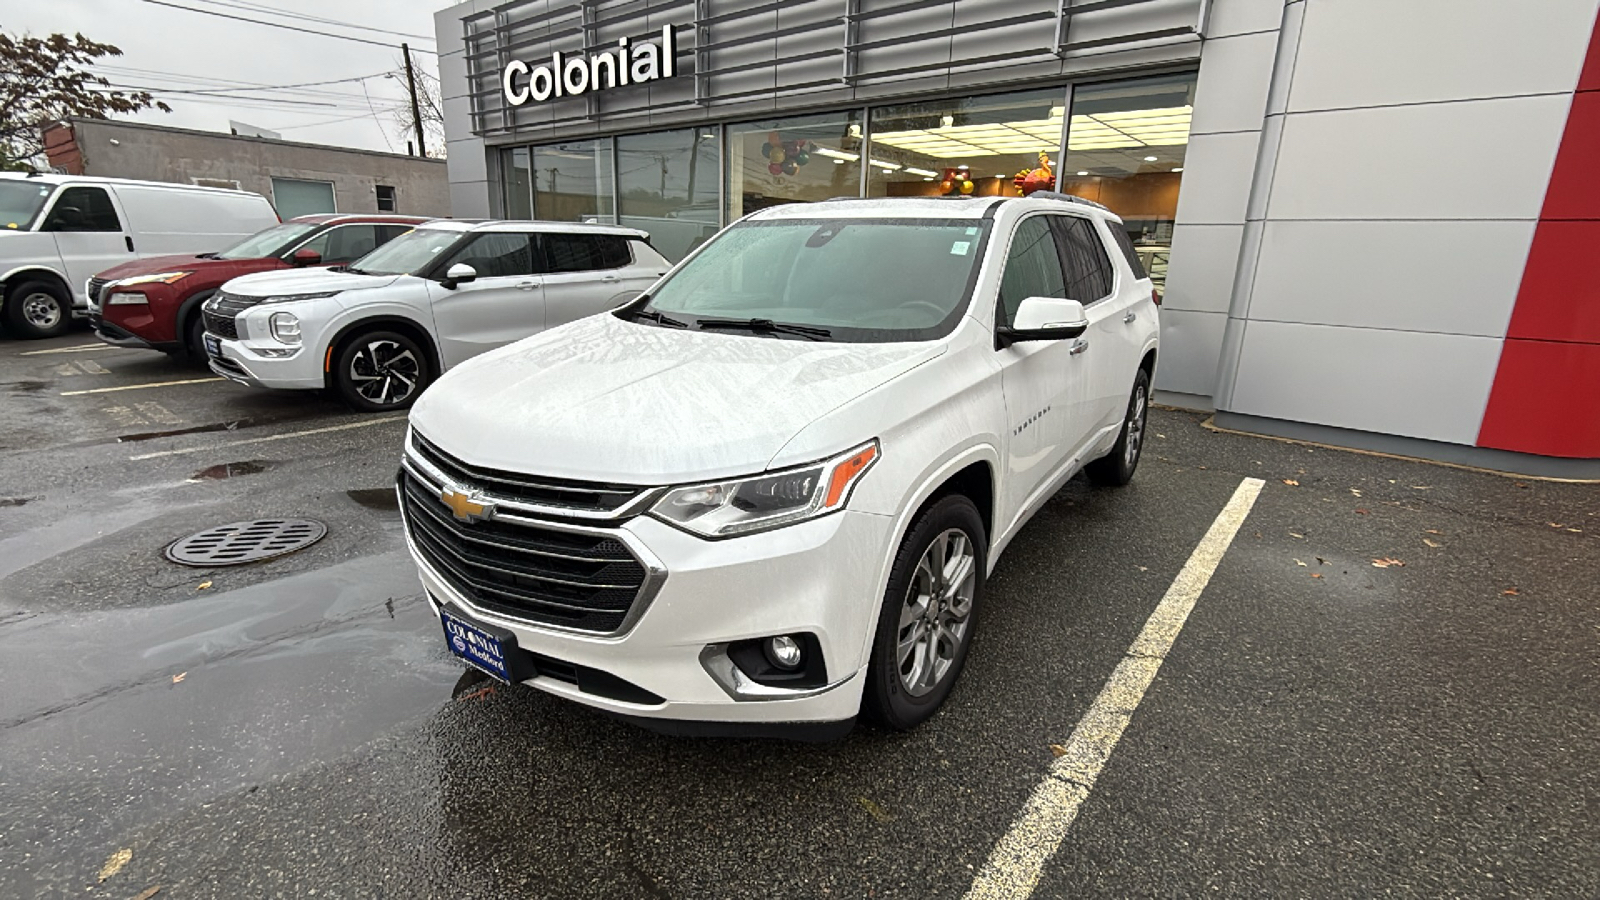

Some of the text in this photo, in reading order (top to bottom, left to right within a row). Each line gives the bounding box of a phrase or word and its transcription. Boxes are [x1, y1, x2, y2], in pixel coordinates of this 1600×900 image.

[503, 23, 673, 106] Colonial
[446, 620, 504, 659] COLONIAL
[468, 643, 504, 671] Medford
